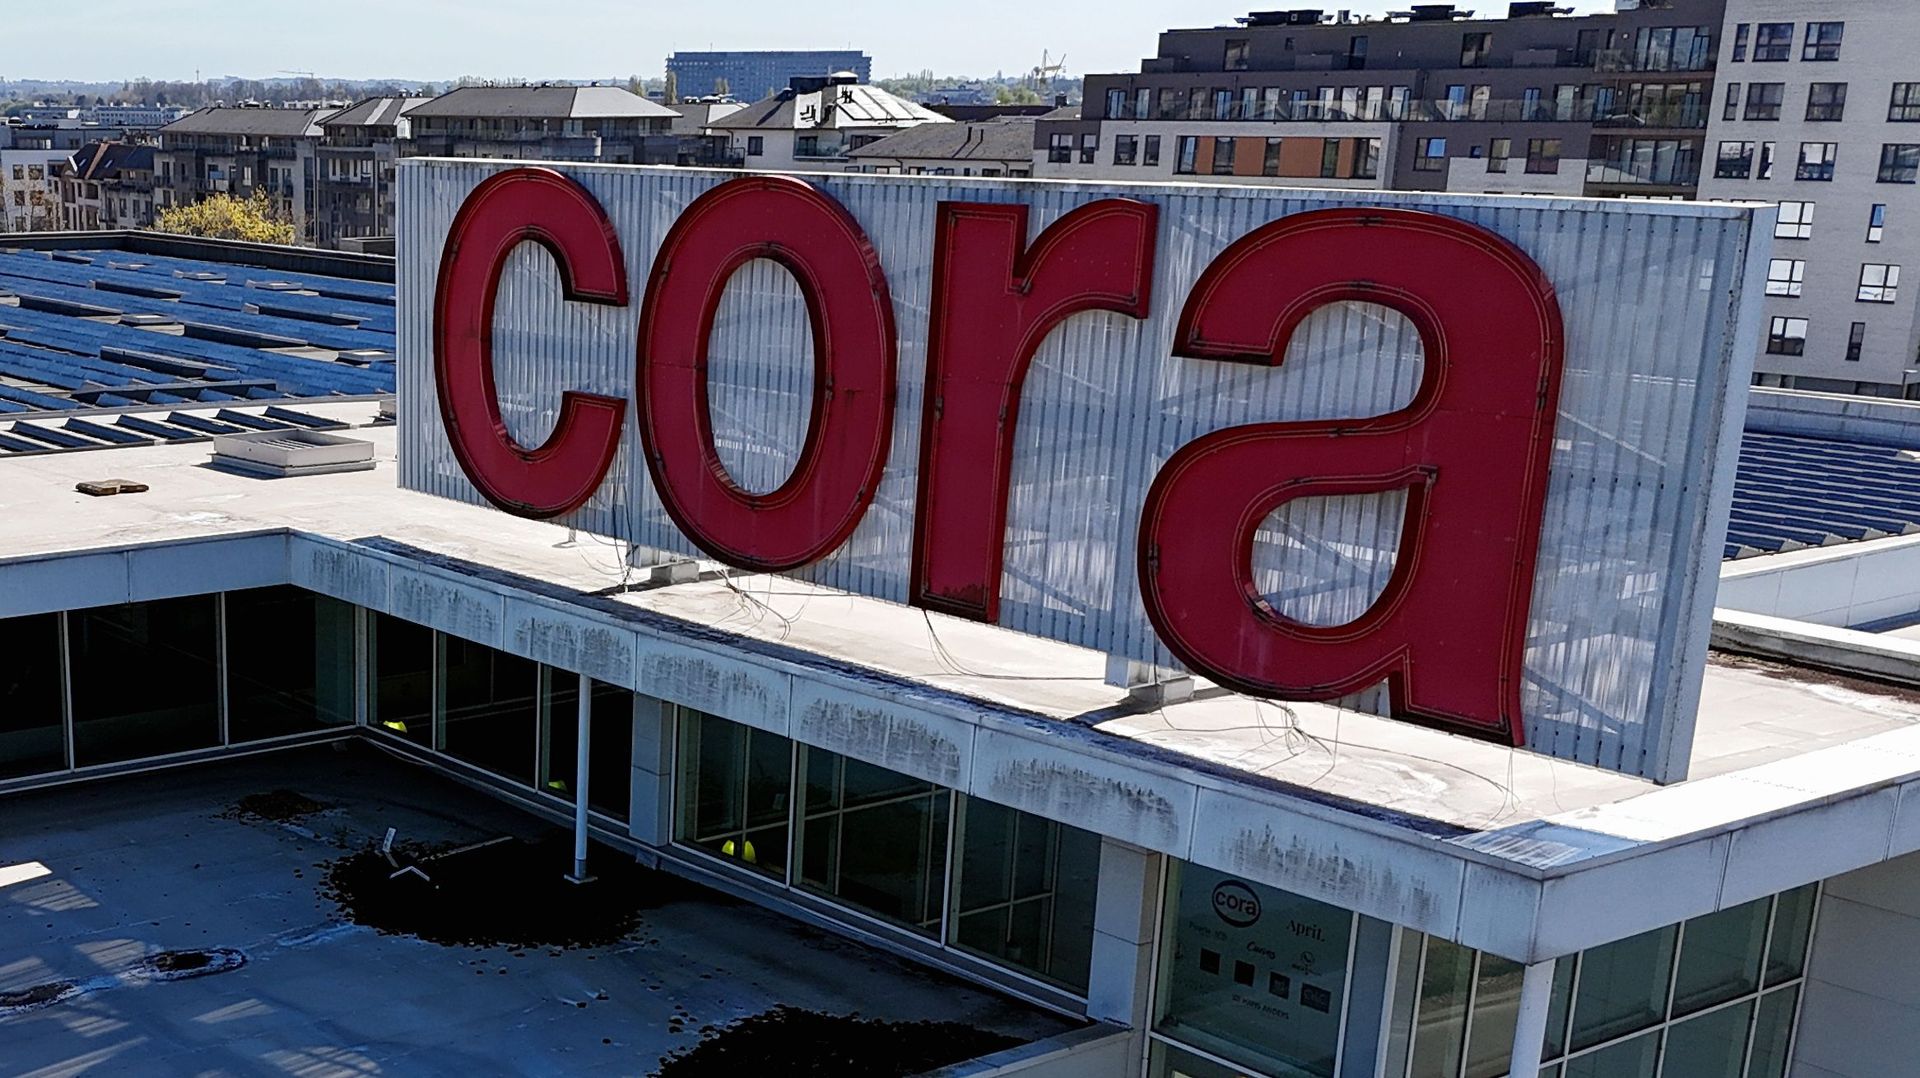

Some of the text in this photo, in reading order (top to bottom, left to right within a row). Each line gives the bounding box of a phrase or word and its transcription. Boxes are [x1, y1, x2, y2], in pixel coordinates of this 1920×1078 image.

[433, 166, 1565, 746] cora
[1215, 890, 1257, 917] cora
[1286, 919, 1326, 942] April.
